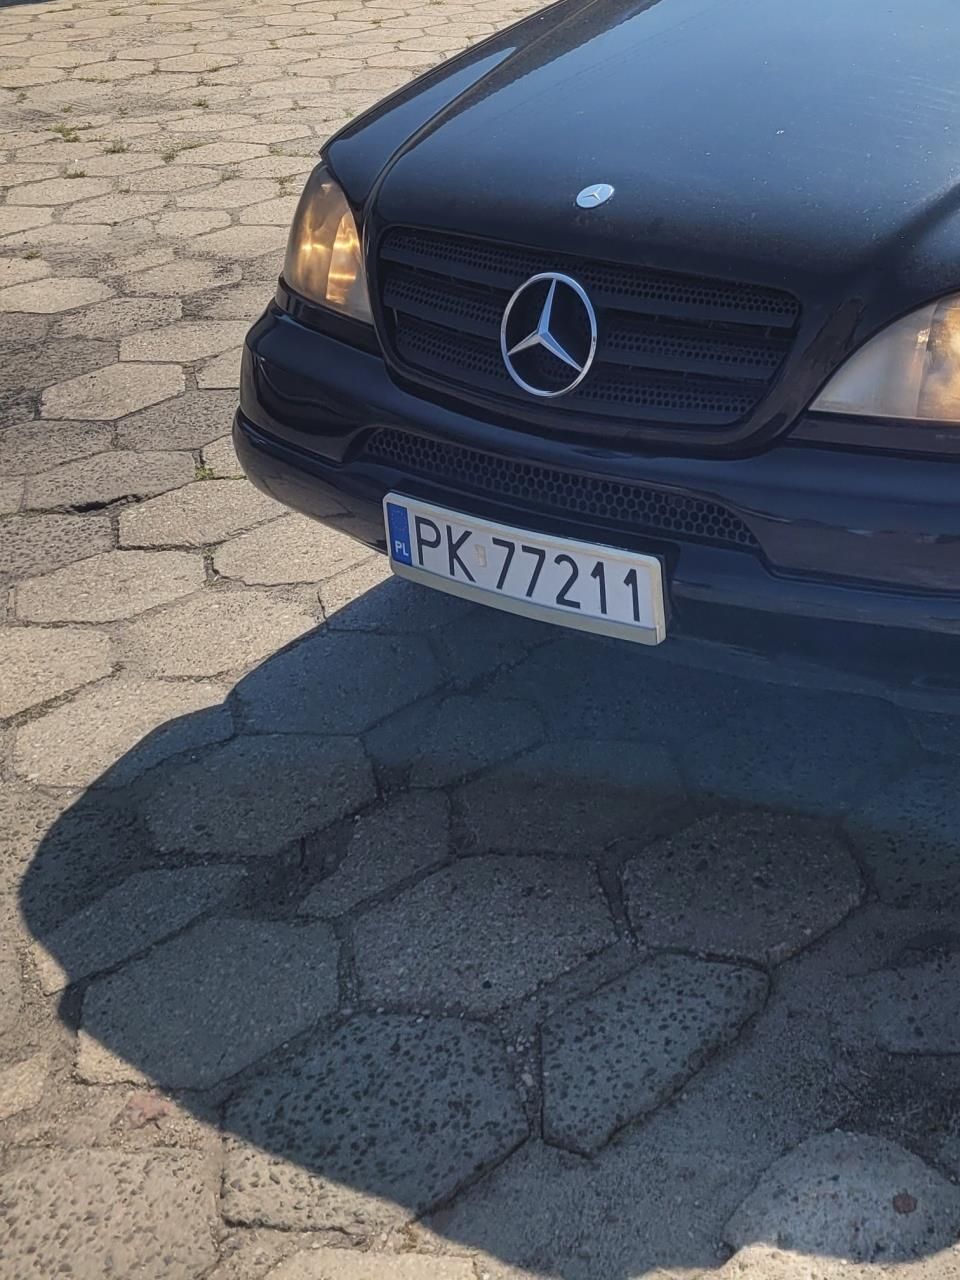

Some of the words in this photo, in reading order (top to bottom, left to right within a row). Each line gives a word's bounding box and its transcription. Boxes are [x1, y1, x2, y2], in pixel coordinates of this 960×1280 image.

[395, 541, 409, 557] PL
[415, 515, 475, 582] PK
[492, 537, 640, 622] 77211
